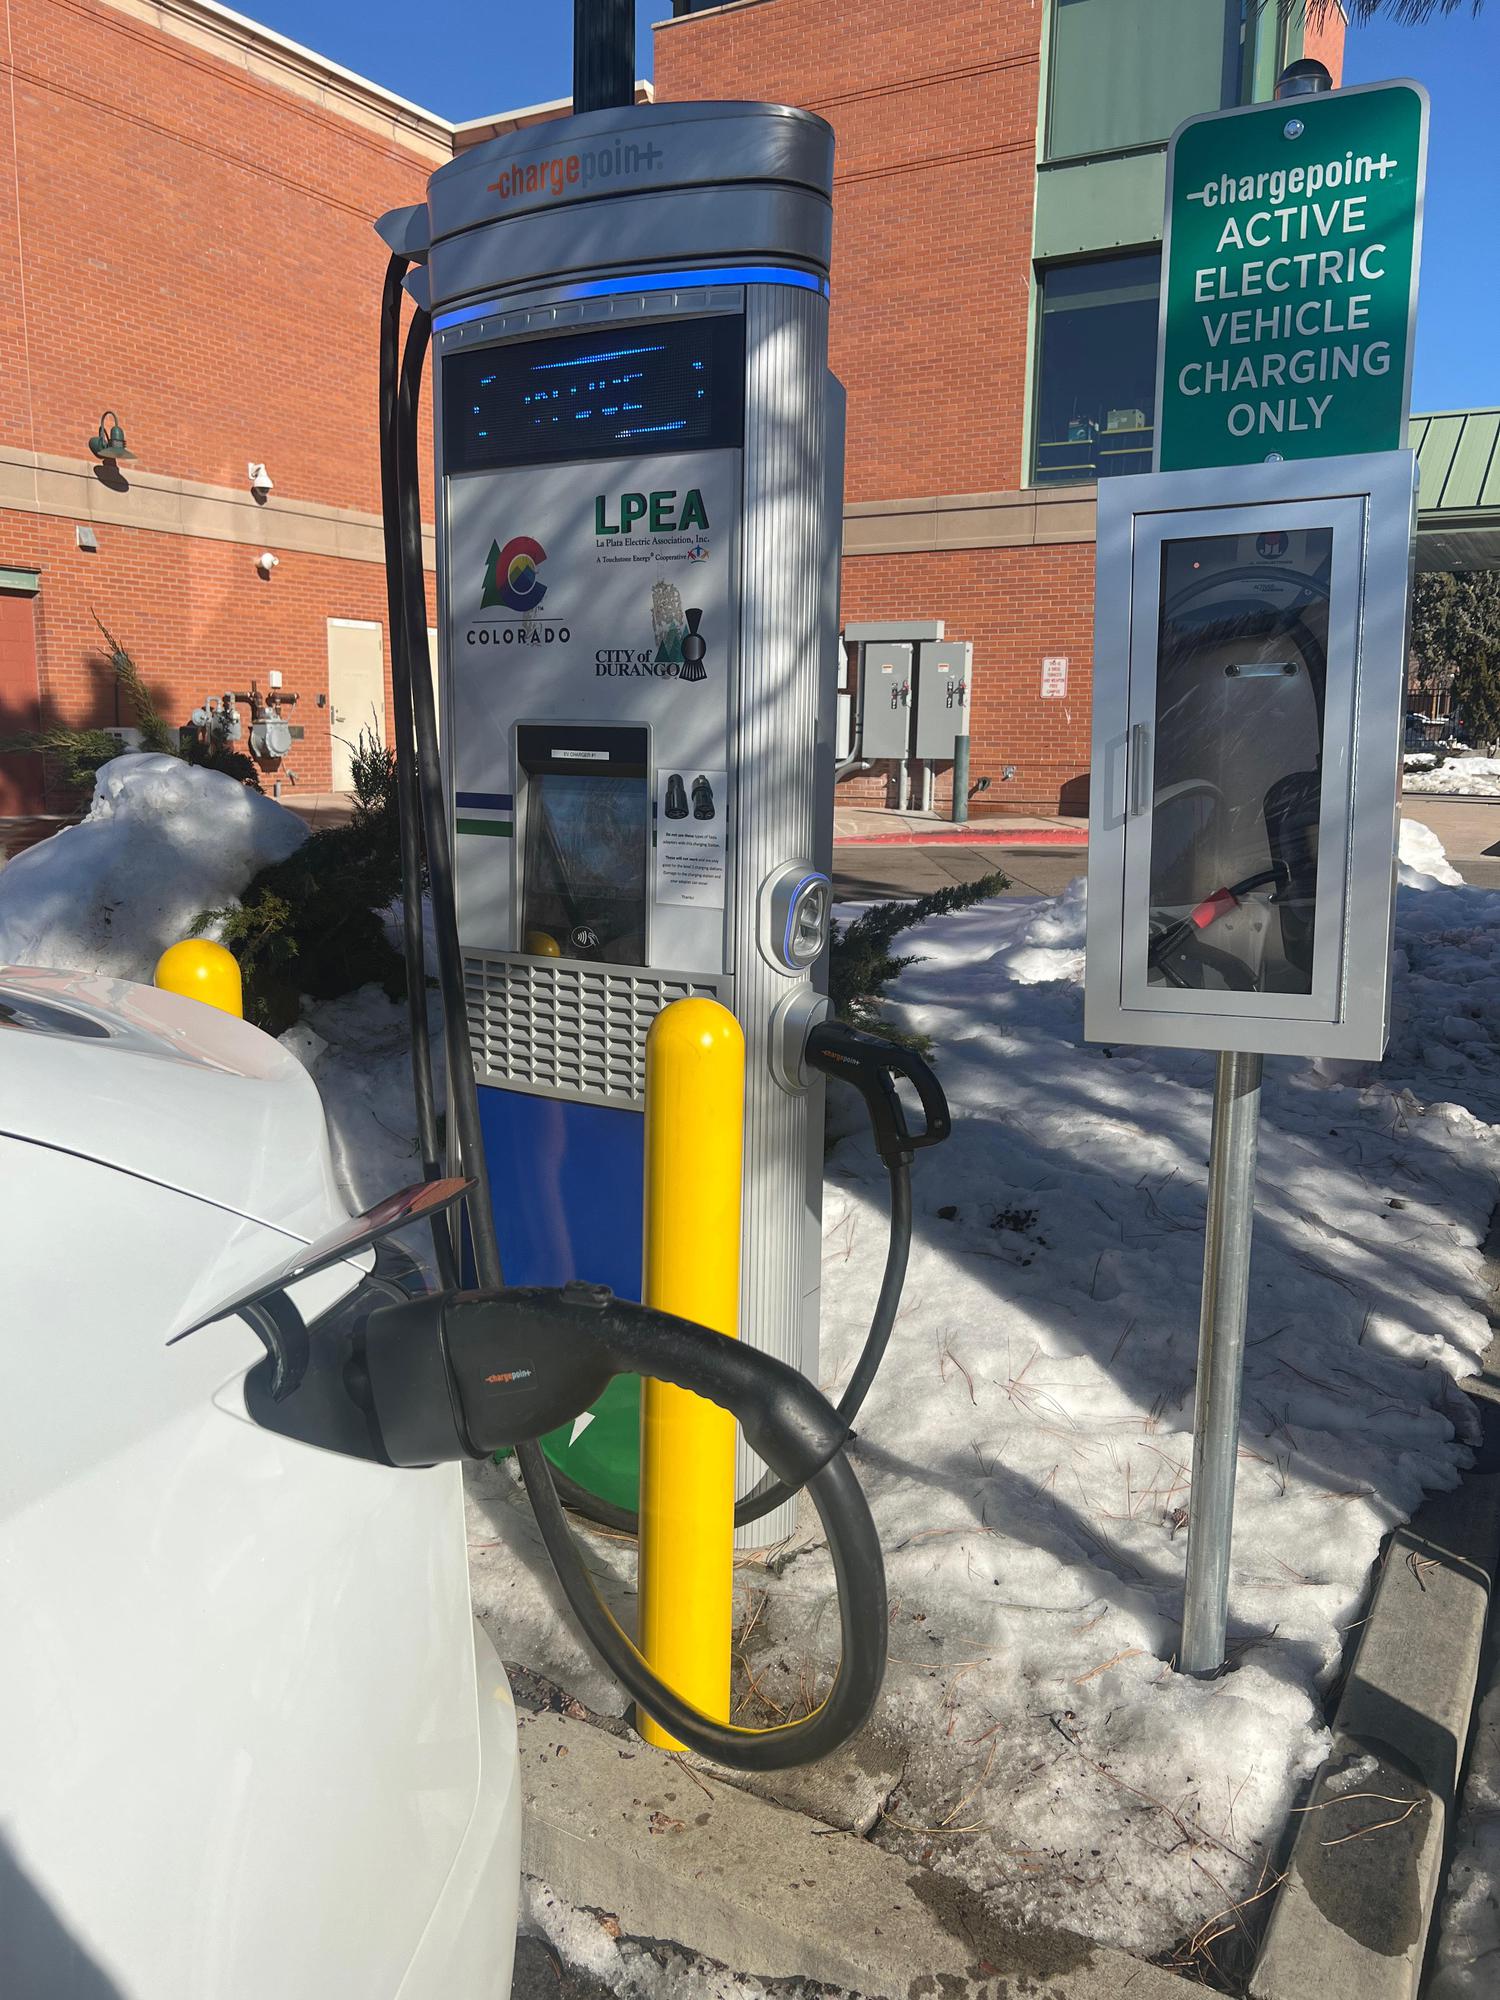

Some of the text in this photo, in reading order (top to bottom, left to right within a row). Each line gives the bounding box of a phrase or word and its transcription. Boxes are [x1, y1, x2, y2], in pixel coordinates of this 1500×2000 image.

[1216, 196, 1367, 252] ACTIVE
[1194, 244, 1386, 302] ELECTRIC
[1202, 294, 1372, 347] VEHICLE
[1178, 341, 1391, 396] CHARGING
[1227, 394, 1333, 436] ONLY
[595, 488, 710, 535] LPEA
[596, 534, 710, 548] La Plata Electric Association, Inc.
[466, 627, 571, 645] COLORADO
[595, 650, 652, 663] CITY of
[595, 662, 681, 678] DURANGO
